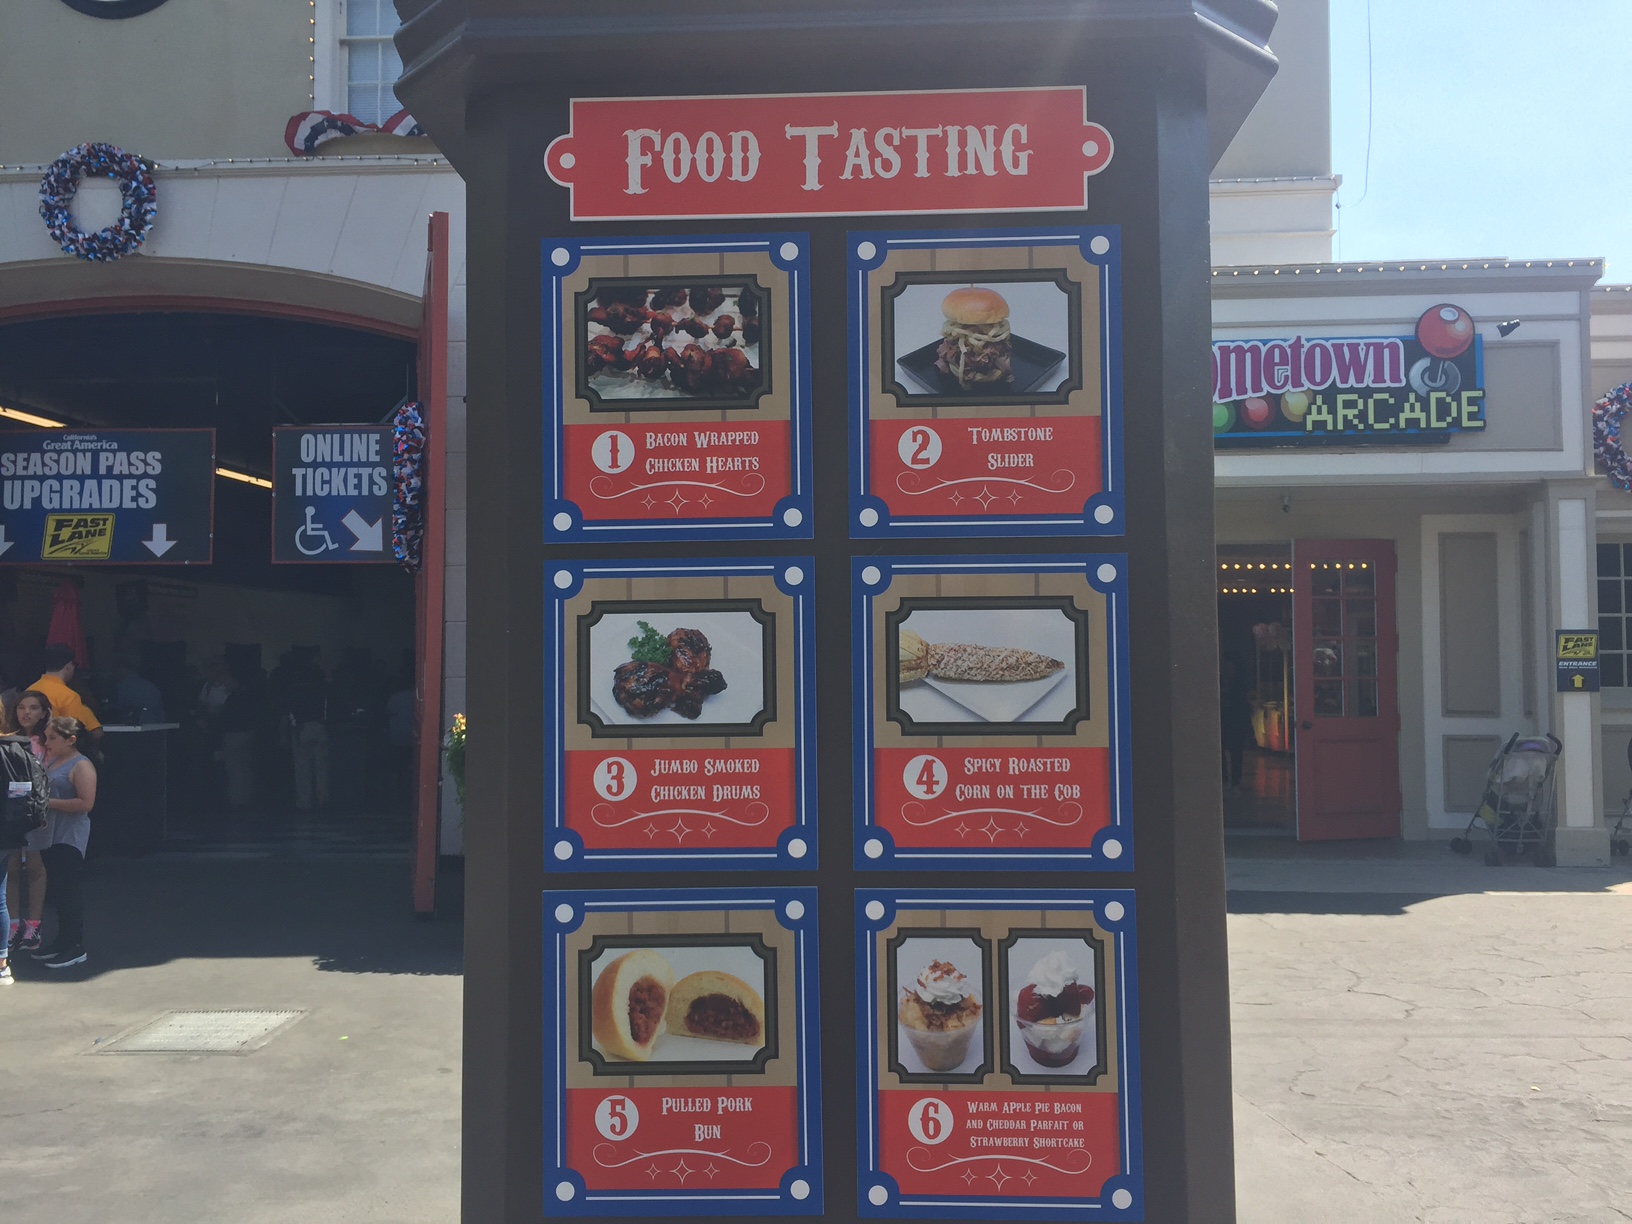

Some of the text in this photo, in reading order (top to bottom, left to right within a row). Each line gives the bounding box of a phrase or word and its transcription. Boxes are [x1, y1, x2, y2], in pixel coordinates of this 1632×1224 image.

[1212, 335, 1404, 401] metown
[1306, 390, 1485, 432] ARCADE
[42, 440, 118, 450] Great America
[645, 431, 759, 449] BACON WRAPPED
[968, 427, 1053, 445] TOMBSTONE
[300, 433, 381, 463] ONLINE
[607, 434, 622, 470] 1
[910, 429, 931, 466] 2
[1, 451, 162, 476] SEASON PASS
[645, 456, 760, 475] CHICKEN HEARTS
[987, 453, 1034, 470] SLIDER
[292, 467, 387, 497] TICKETS
[3, 478, 157, 510] UPGRADES
[53, 517, 109, 533] FAST
[49, 528, 107, 548] LANE
[1561, 642, 1594, 652] LANE
[1564, 636, 1594, 645] FAST
[650, 758, 760, 777] JUMBO SMOKED
[964, 757, 1071, 775] SPICY ROASTED
[605, 760, 625, 797] 3
[916, 758, 940, 795] 4
[650, 784, 761, 803] CHICKEN DRUMS
[955, 783, 991, 801] CORN
[1054, 783, 1081, 801] COB
[661, 1096, 753, 1115] PULLED PORK
[967, 1101, 1082, 1114] WARM APPLE PIE BACON
[606, 1097, 628, 1137] 5
[919, 1101, 942, 1140] 6
[694, 1123, 721, 1142] BUN
[970, 1136, 1085, 1149] STRAWBERRY SHORTCAKE
